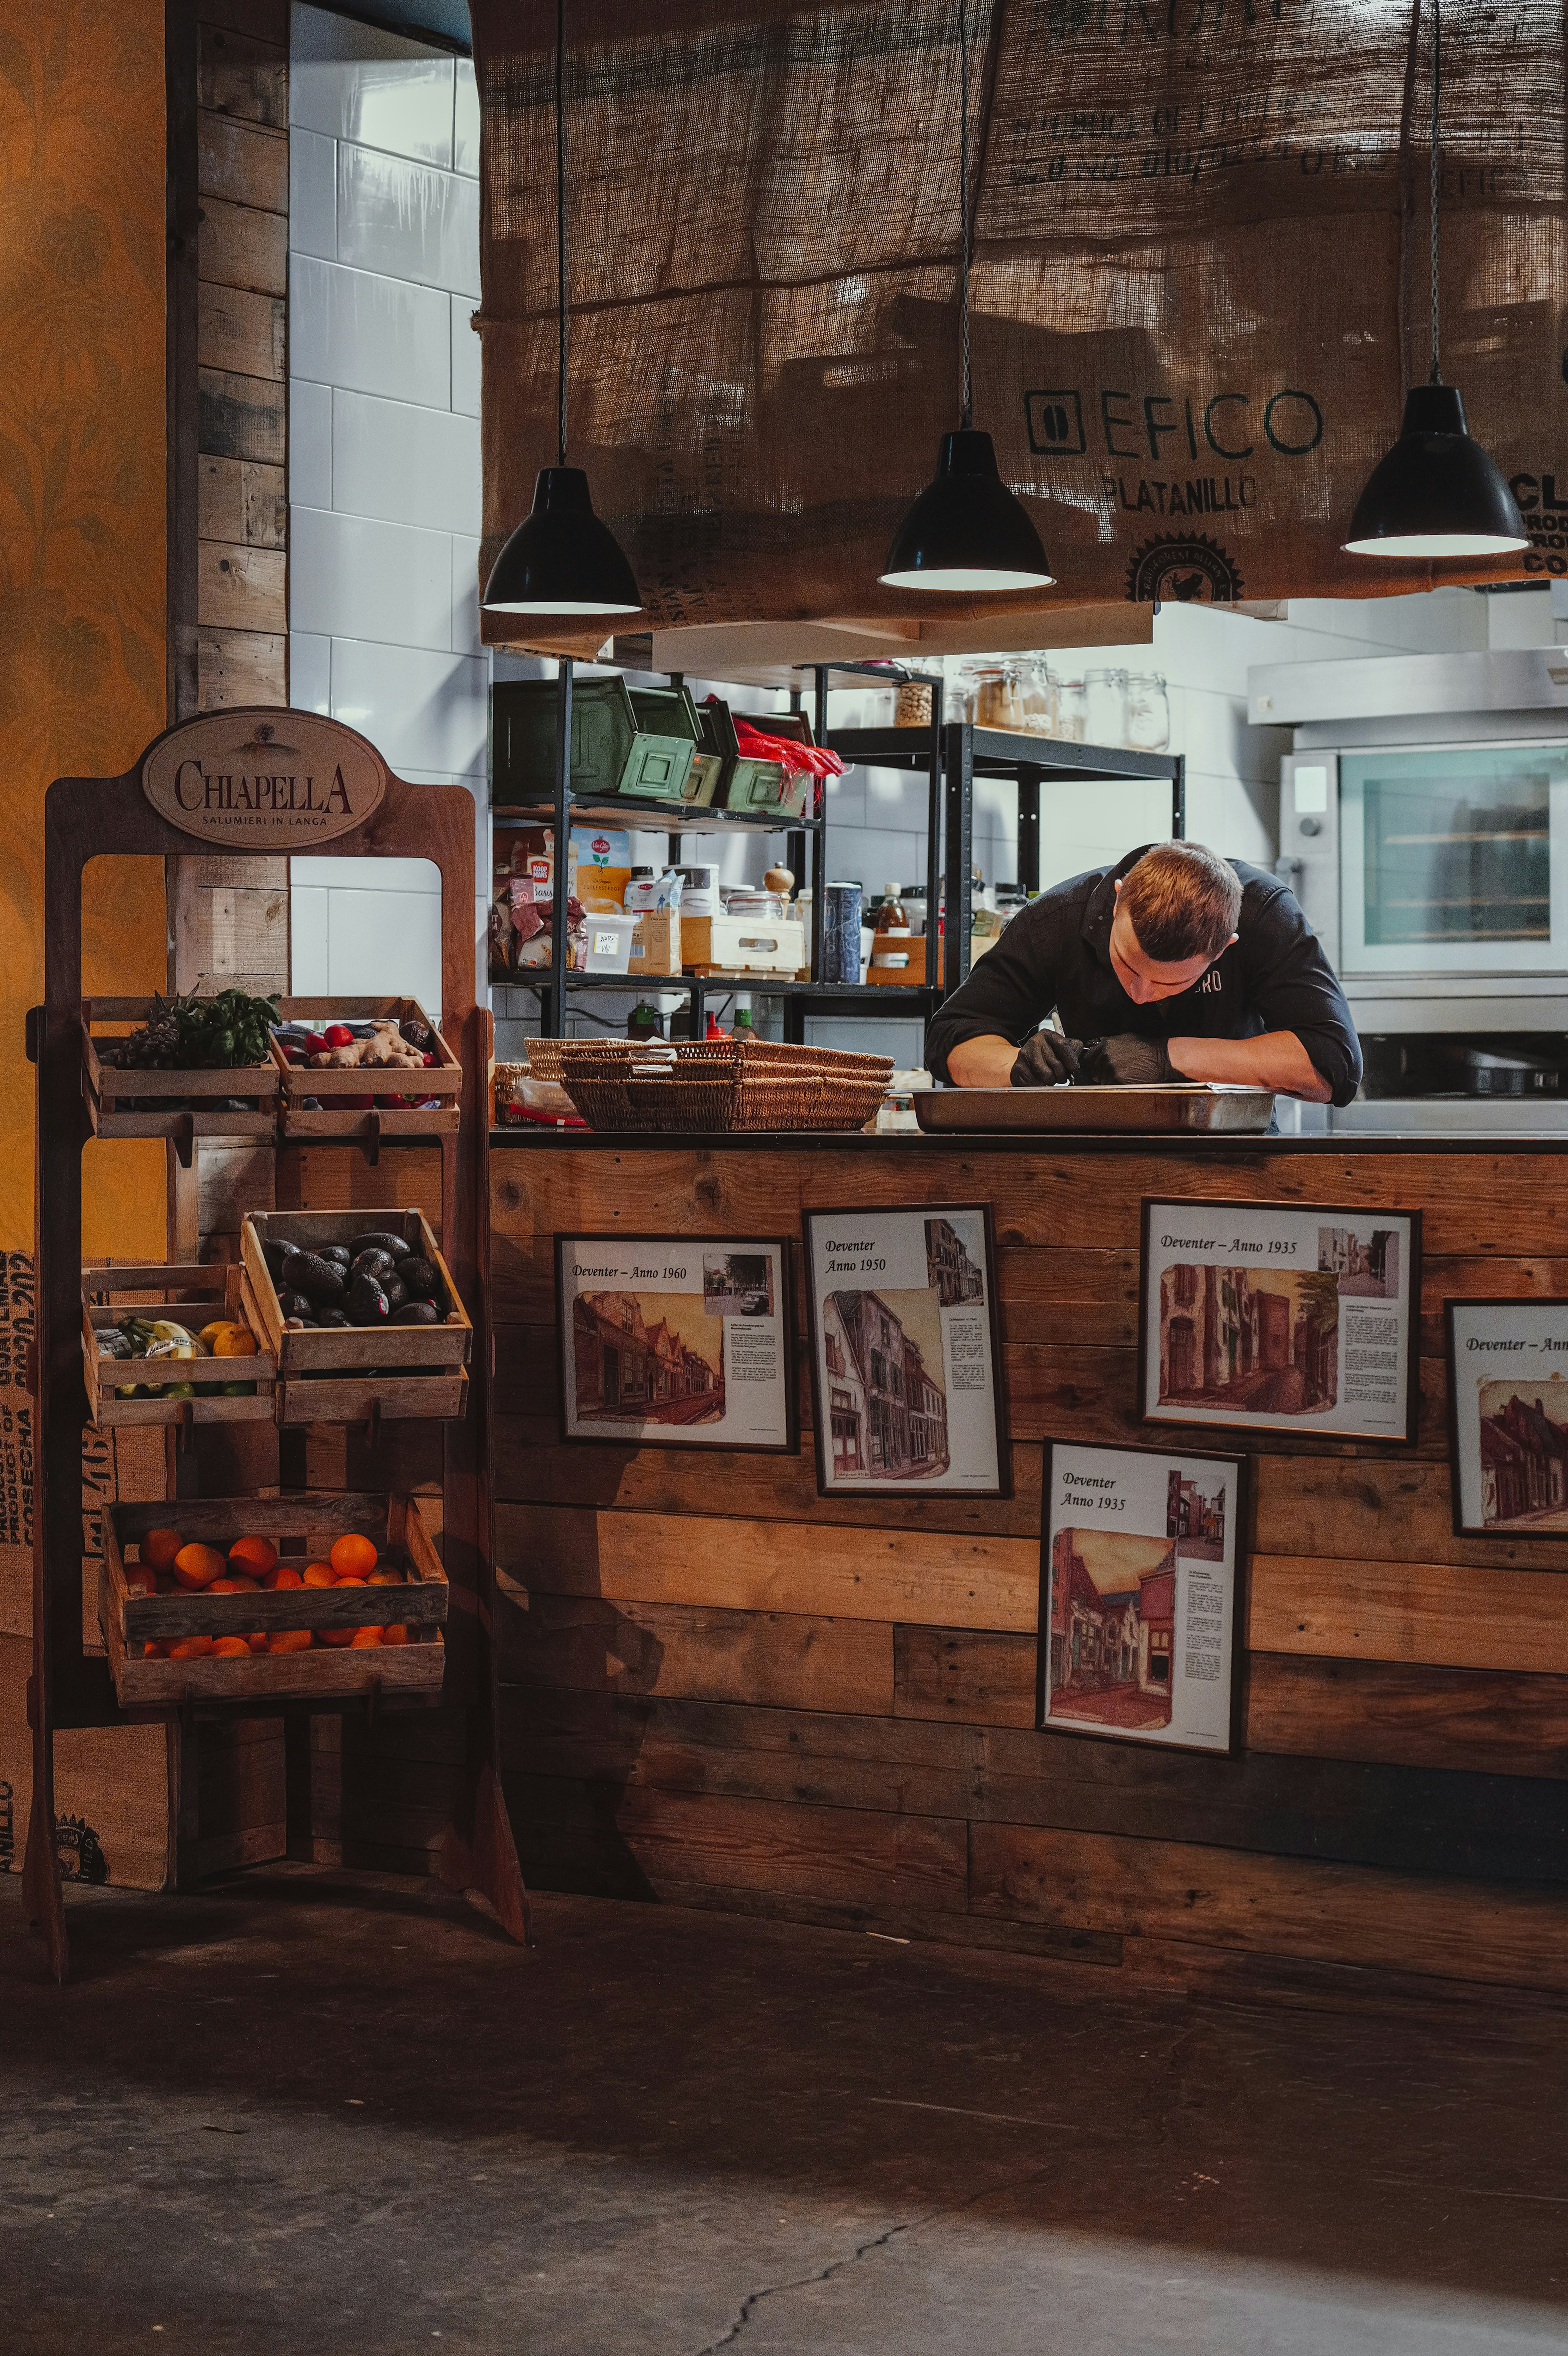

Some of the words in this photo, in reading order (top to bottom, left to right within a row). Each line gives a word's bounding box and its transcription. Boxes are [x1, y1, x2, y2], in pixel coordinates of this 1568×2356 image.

[1102, 390, 1322, 460] EFICO
[1102, 476, 1257, 516] PLATANILLO
[1522, 514, 1568, 532] ROD
[175, 760, 353, 814] CHIAPELLA
[203, 816, 266, 825] SALUMIERI
[272, 817, 283, 825] IN
[289, 817, 327, 825] LANGA
[1194, 970, 1222, 993] RO
[825, 1240, 875, 1252] Deventer
[1161, 1235, 1216, 1250] Deventer
[1229, 1239, 1263, 1252] Anno
[1268, 1240, 1297, 1254] 1935
[572, 1265, 619, 1277] Deventer
[629, 1266, 658, 1279] Anno
[662, 1267, 687, 1279] 1960
[825, 1259, 856, 1273] Anno
[860, 1259, 886, 1271] 1950
[1466, 1338, 1526, 1351] Deventer
[1, 1404, 13, 1432] OF
[17, 1409, 34, 1547] COSECHA
[1063, 1472, 1117, 1489] Deventer
[4, 1440, 20, 1545] PRODUCT
[1060, 1493, 1094, 1508] Anno
[1098, 1497, 1126, 1511] 1935
